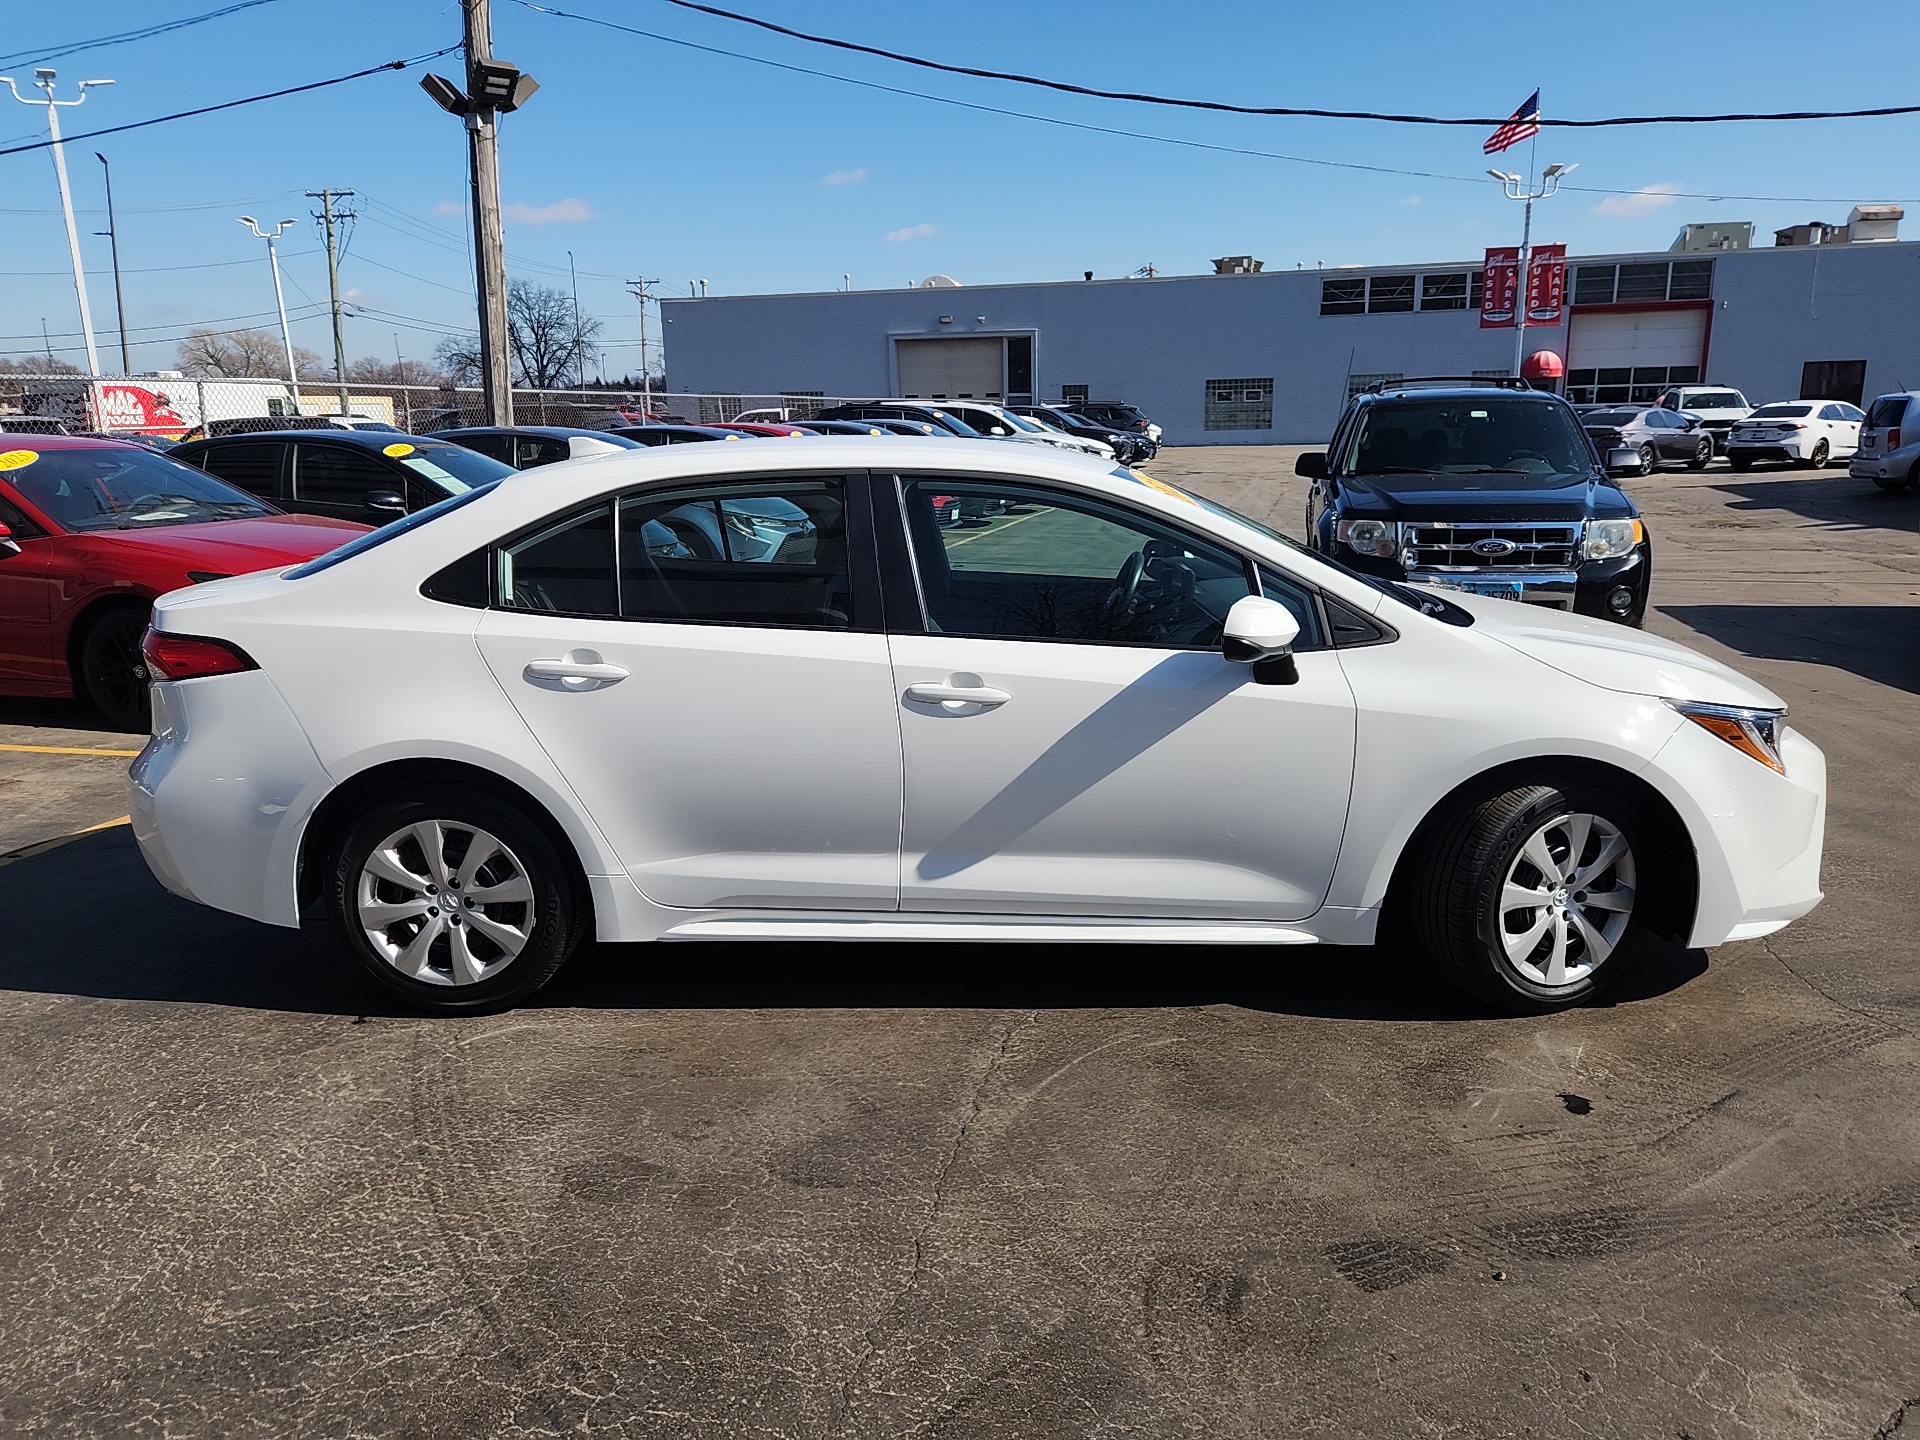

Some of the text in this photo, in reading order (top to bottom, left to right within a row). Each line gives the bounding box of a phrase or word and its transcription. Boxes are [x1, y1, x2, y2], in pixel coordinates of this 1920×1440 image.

[1485, 268, 1495, 310] USED
[1504, 267, 1514, 309] CARS
[1531, 266, 1541, 308] USED
[1550, 265, 1561, 307] CARS
[106, 415, 146, 425] TOOLS
